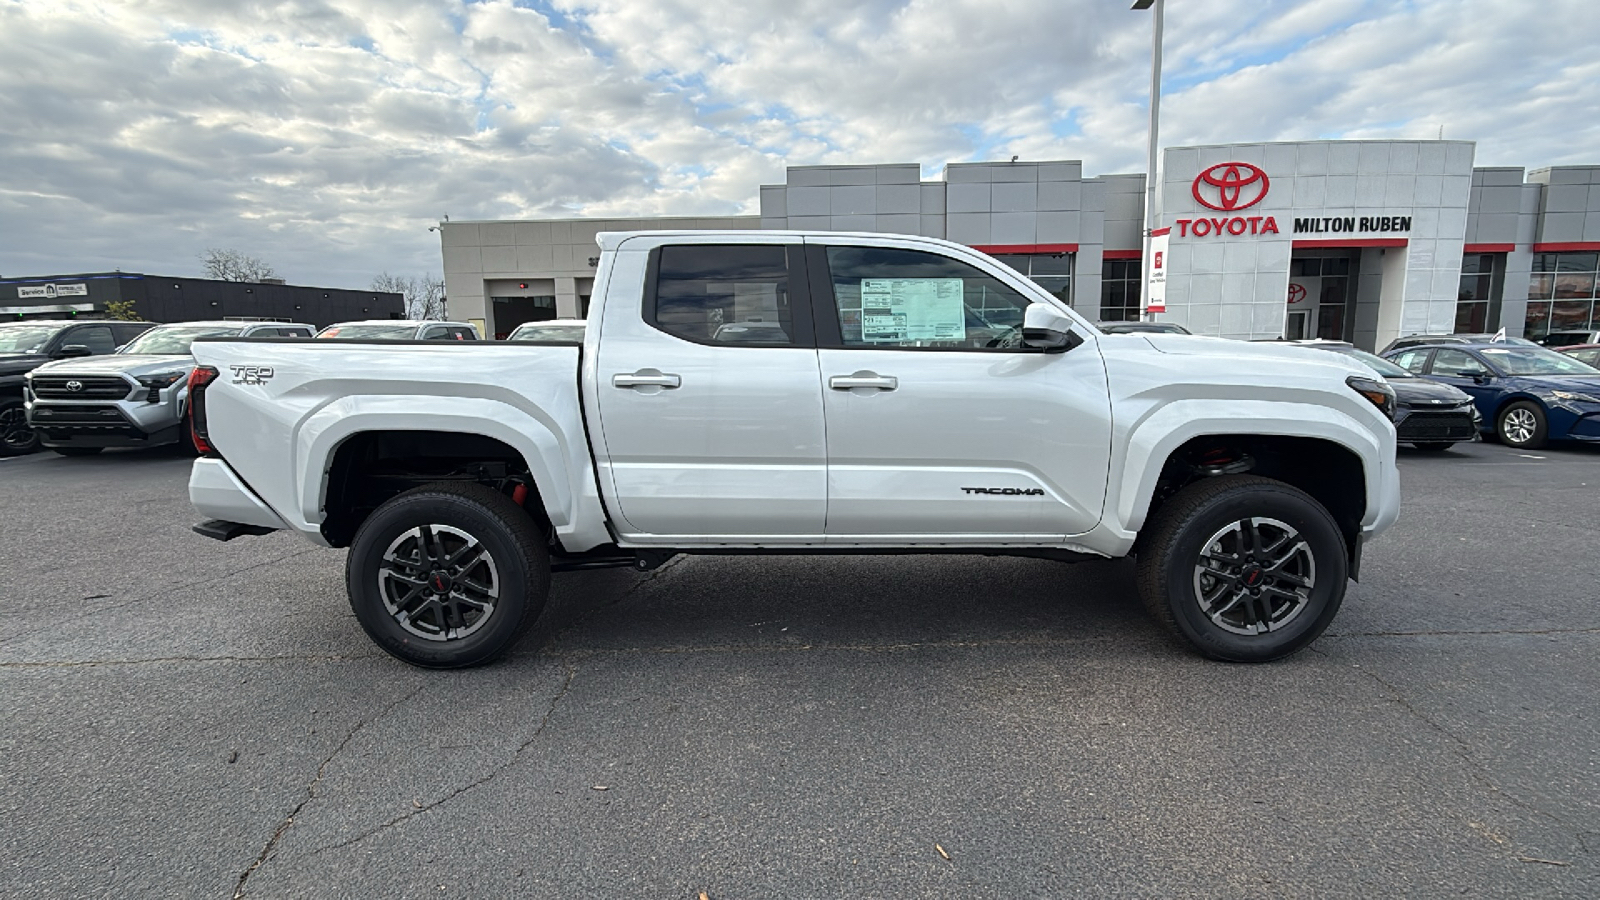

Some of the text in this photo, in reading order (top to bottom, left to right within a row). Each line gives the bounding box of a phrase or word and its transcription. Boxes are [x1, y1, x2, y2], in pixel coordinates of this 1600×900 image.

[1176, 216, 1279, 237] TOYOTA
[1293, 216, 1412, 233] MILTON RUBEN
[21, 288, 45, 296] Service
[230, 365, 274, 381] TRD
[960, 487, 1045, 496] TACOMA
